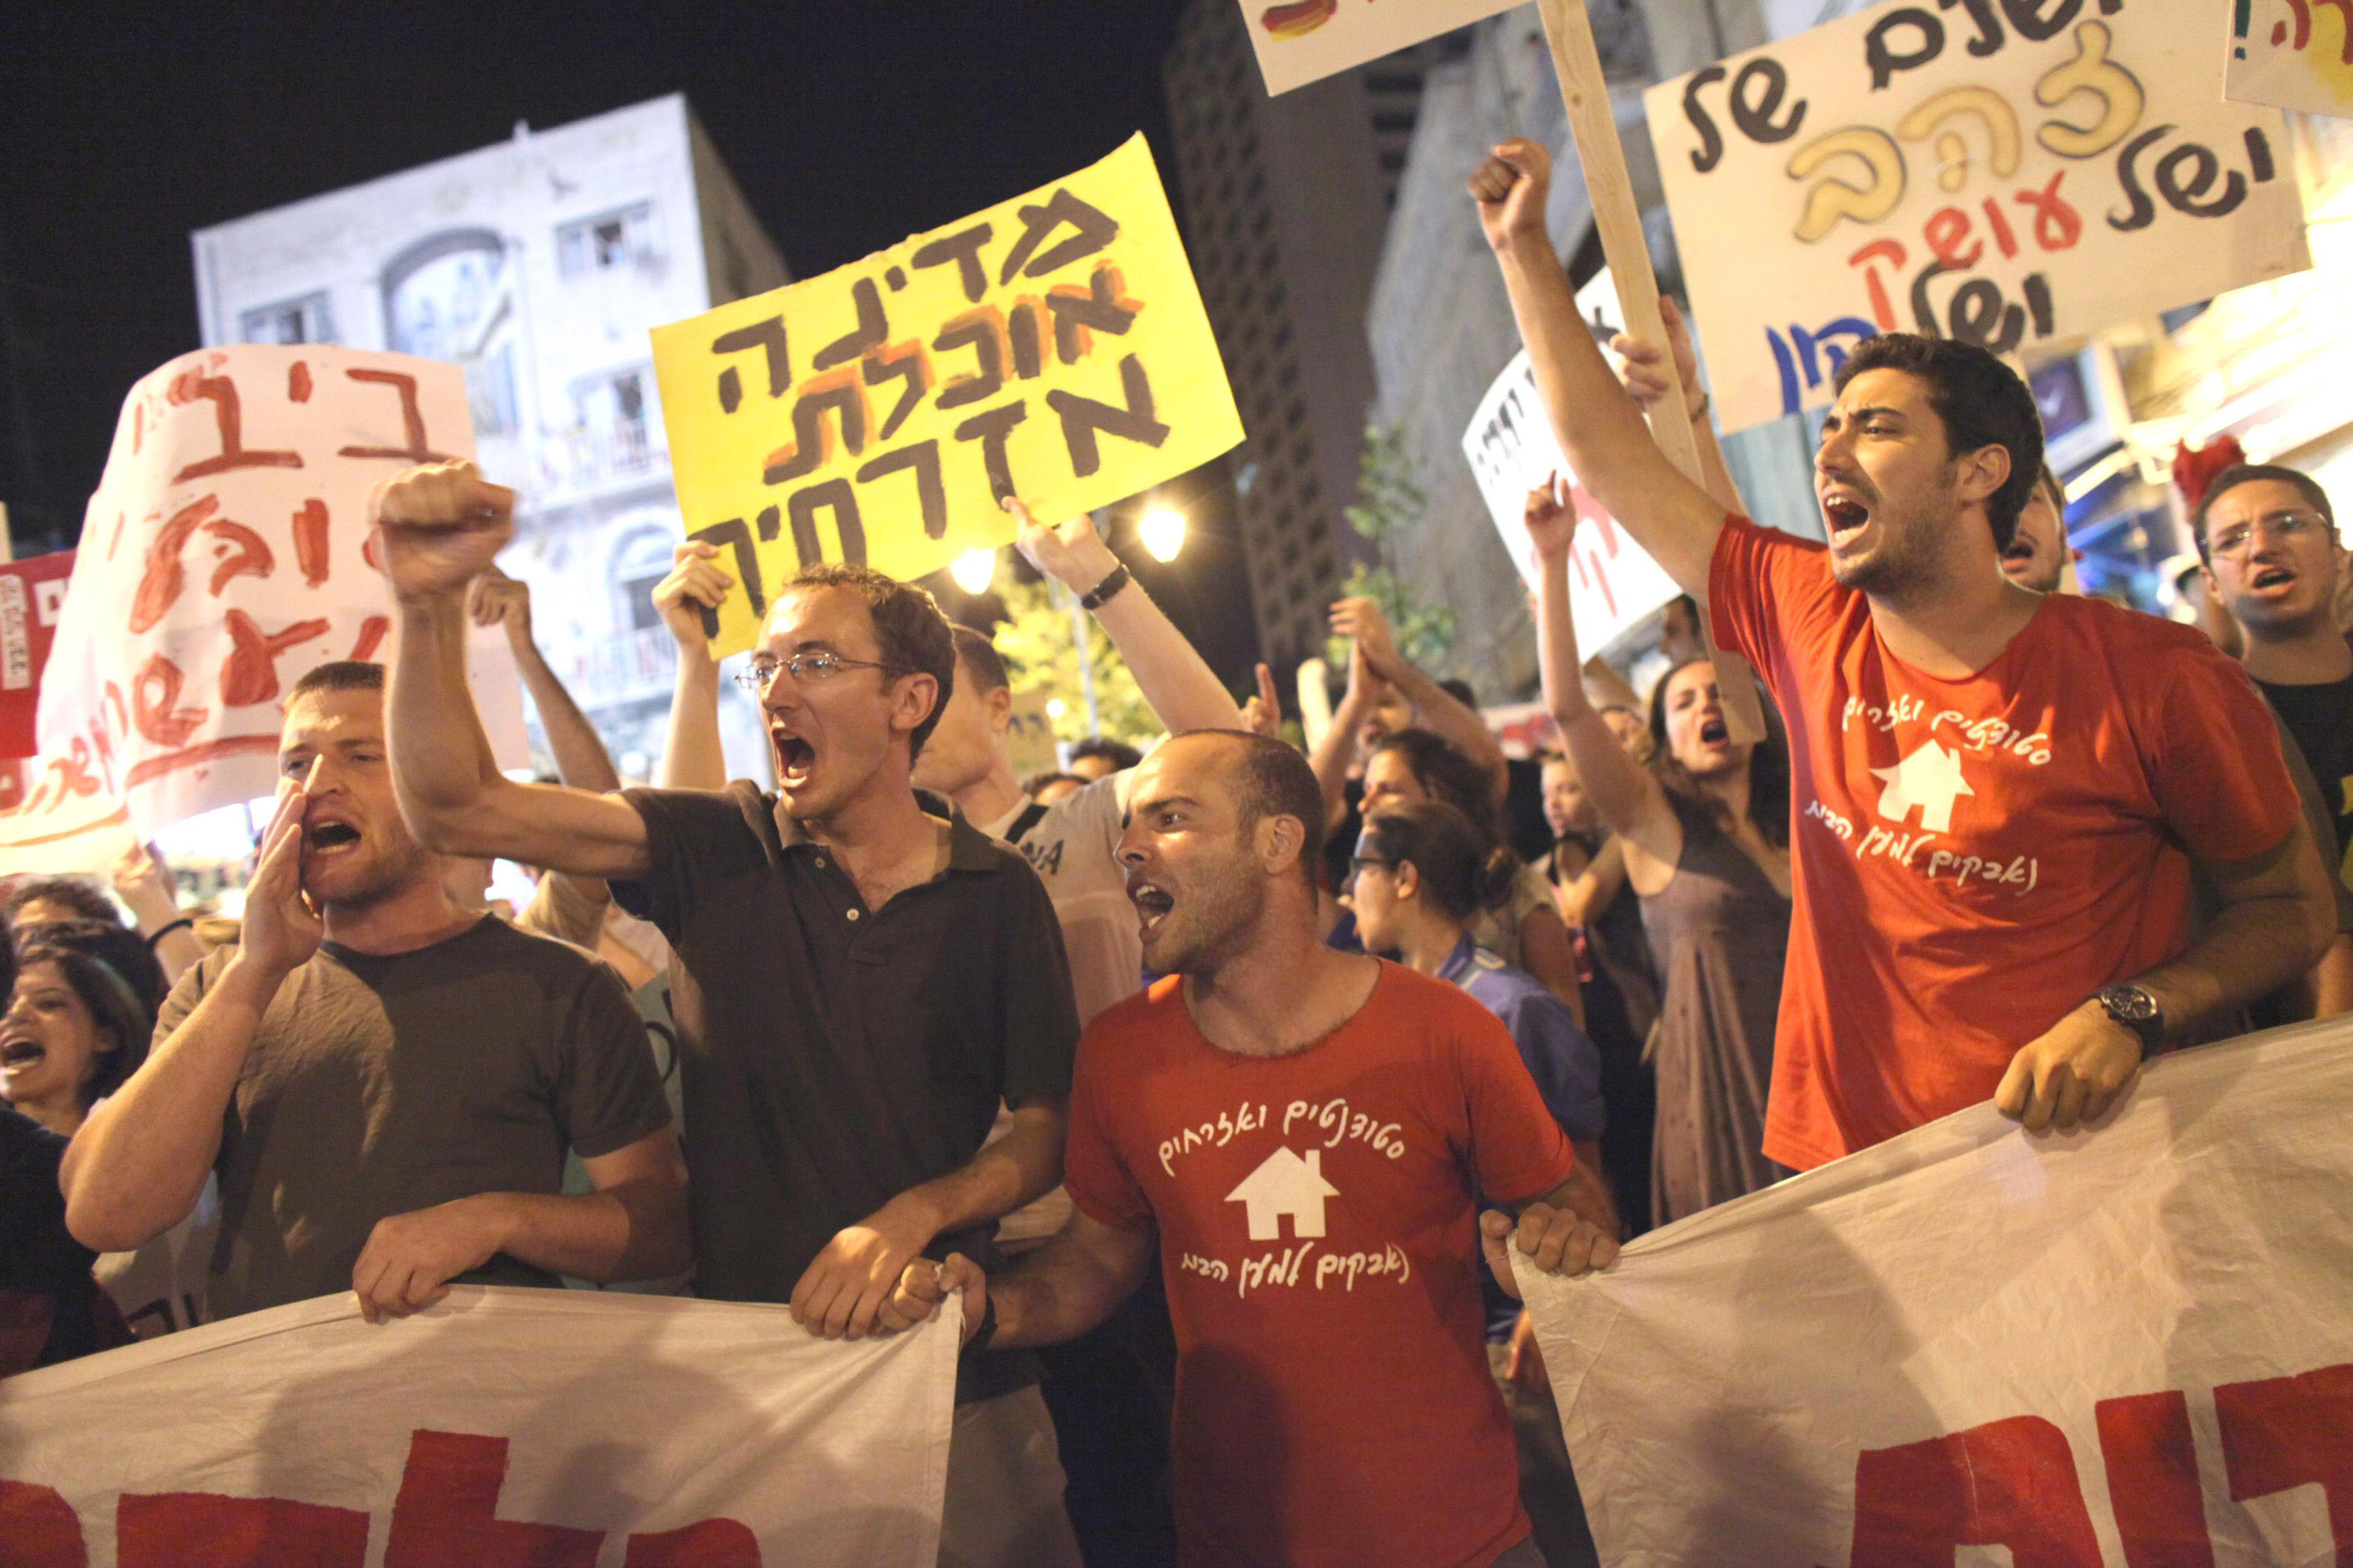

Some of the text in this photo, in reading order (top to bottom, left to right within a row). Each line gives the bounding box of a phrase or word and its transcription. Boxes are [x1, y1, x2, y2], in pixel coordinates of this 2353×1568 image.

[1682, 57, 1808, 173] של
[1848, 123, 2275, 333] ושל עושק
[711, 186, 1121, 415] מדינה
[762, 257, 1146, 487] אוכלת
[685, 352, 1172, 641] אזרחיה
[1930, 709, 2053, 766] סטודנטים
[1855, 825, 1936, 867] למען
[1927, 850, 2038, 897] נאבקים
[1158, 1098, 1405, 1178] סטודנטים ואזרחים
[1181, 1240, 1410, 1300] נאבקים למען הבית
